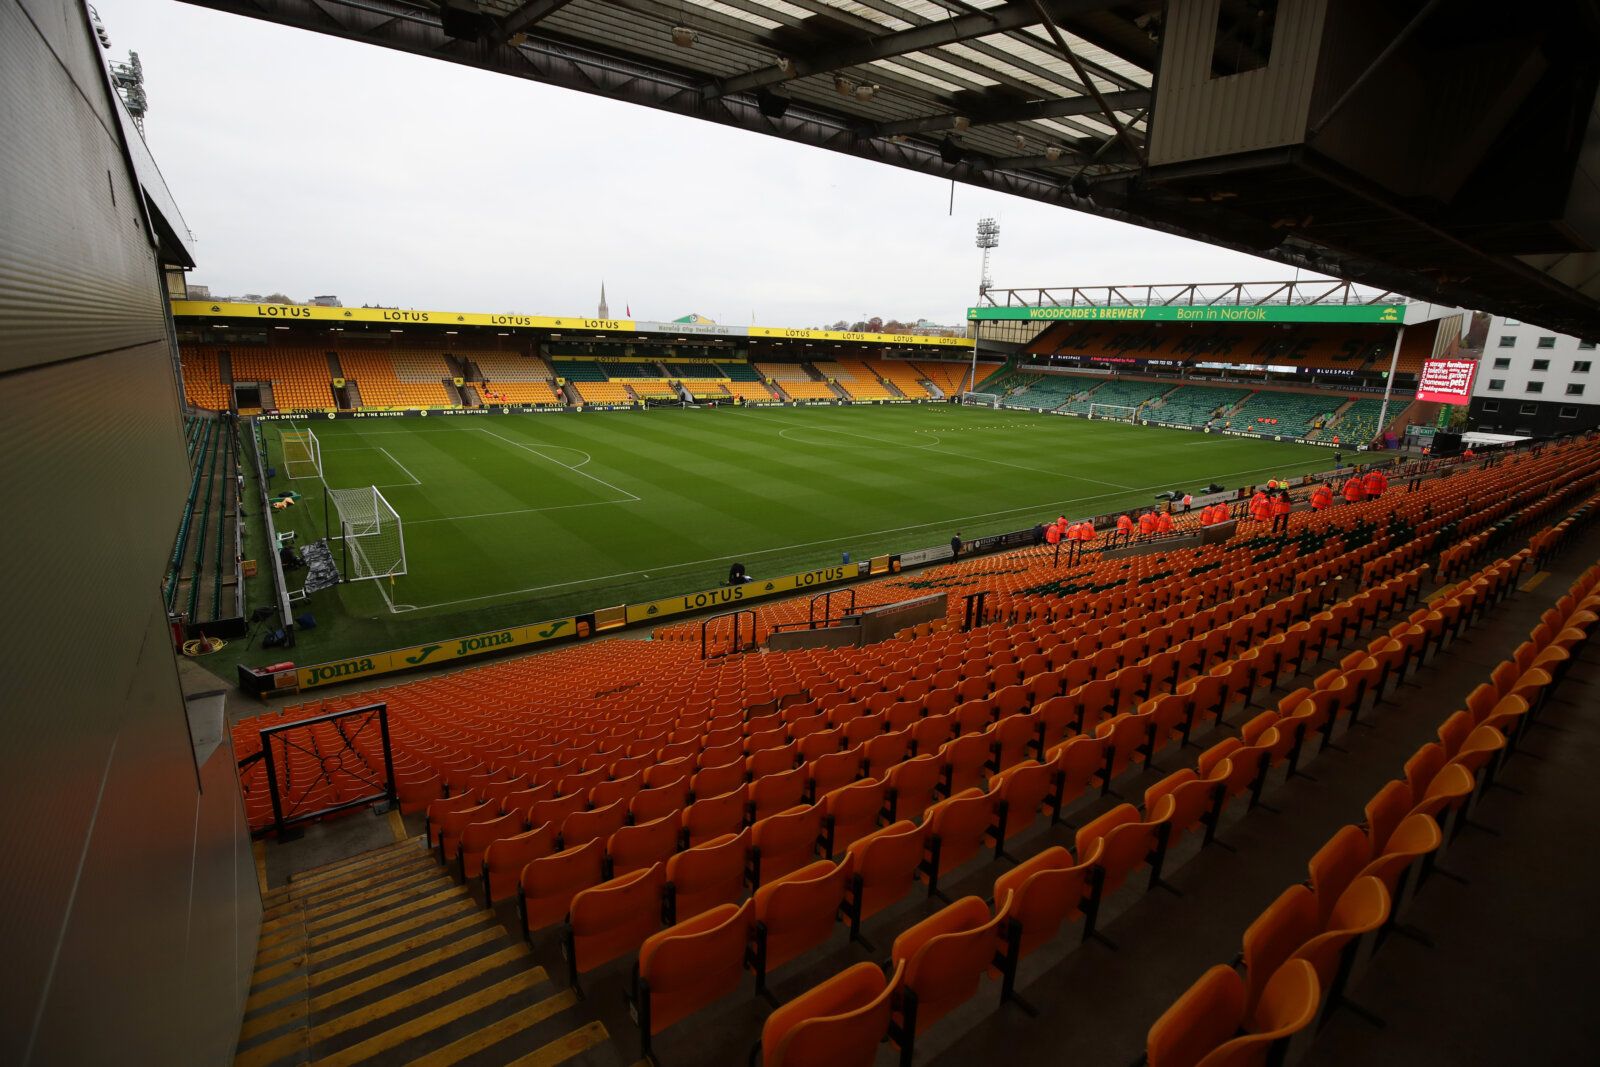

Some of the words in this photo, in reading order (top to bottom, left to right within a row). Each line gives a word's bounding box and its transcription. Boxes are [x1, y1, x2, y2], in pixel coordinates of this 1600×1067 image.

[258, 306, 311, 317] LOTUS
[384, 311, 429, 322] LOTUS
[1030, 308, 1097, 319] WOODFORDE'S
[1100, 308, 1146, 318] BREWERY
[1176, 308, 1203, 319] Born
[1206, 308, 1217, 319] in
[1220, 308, 1266, 320] Norfolk
[491, 316, 530, 326] LOTUS
[585, 320, 619, 329] LOTUS
[795, 567, 844, 587] LOTUS
[684, 587, 743, 610] LOTUS
